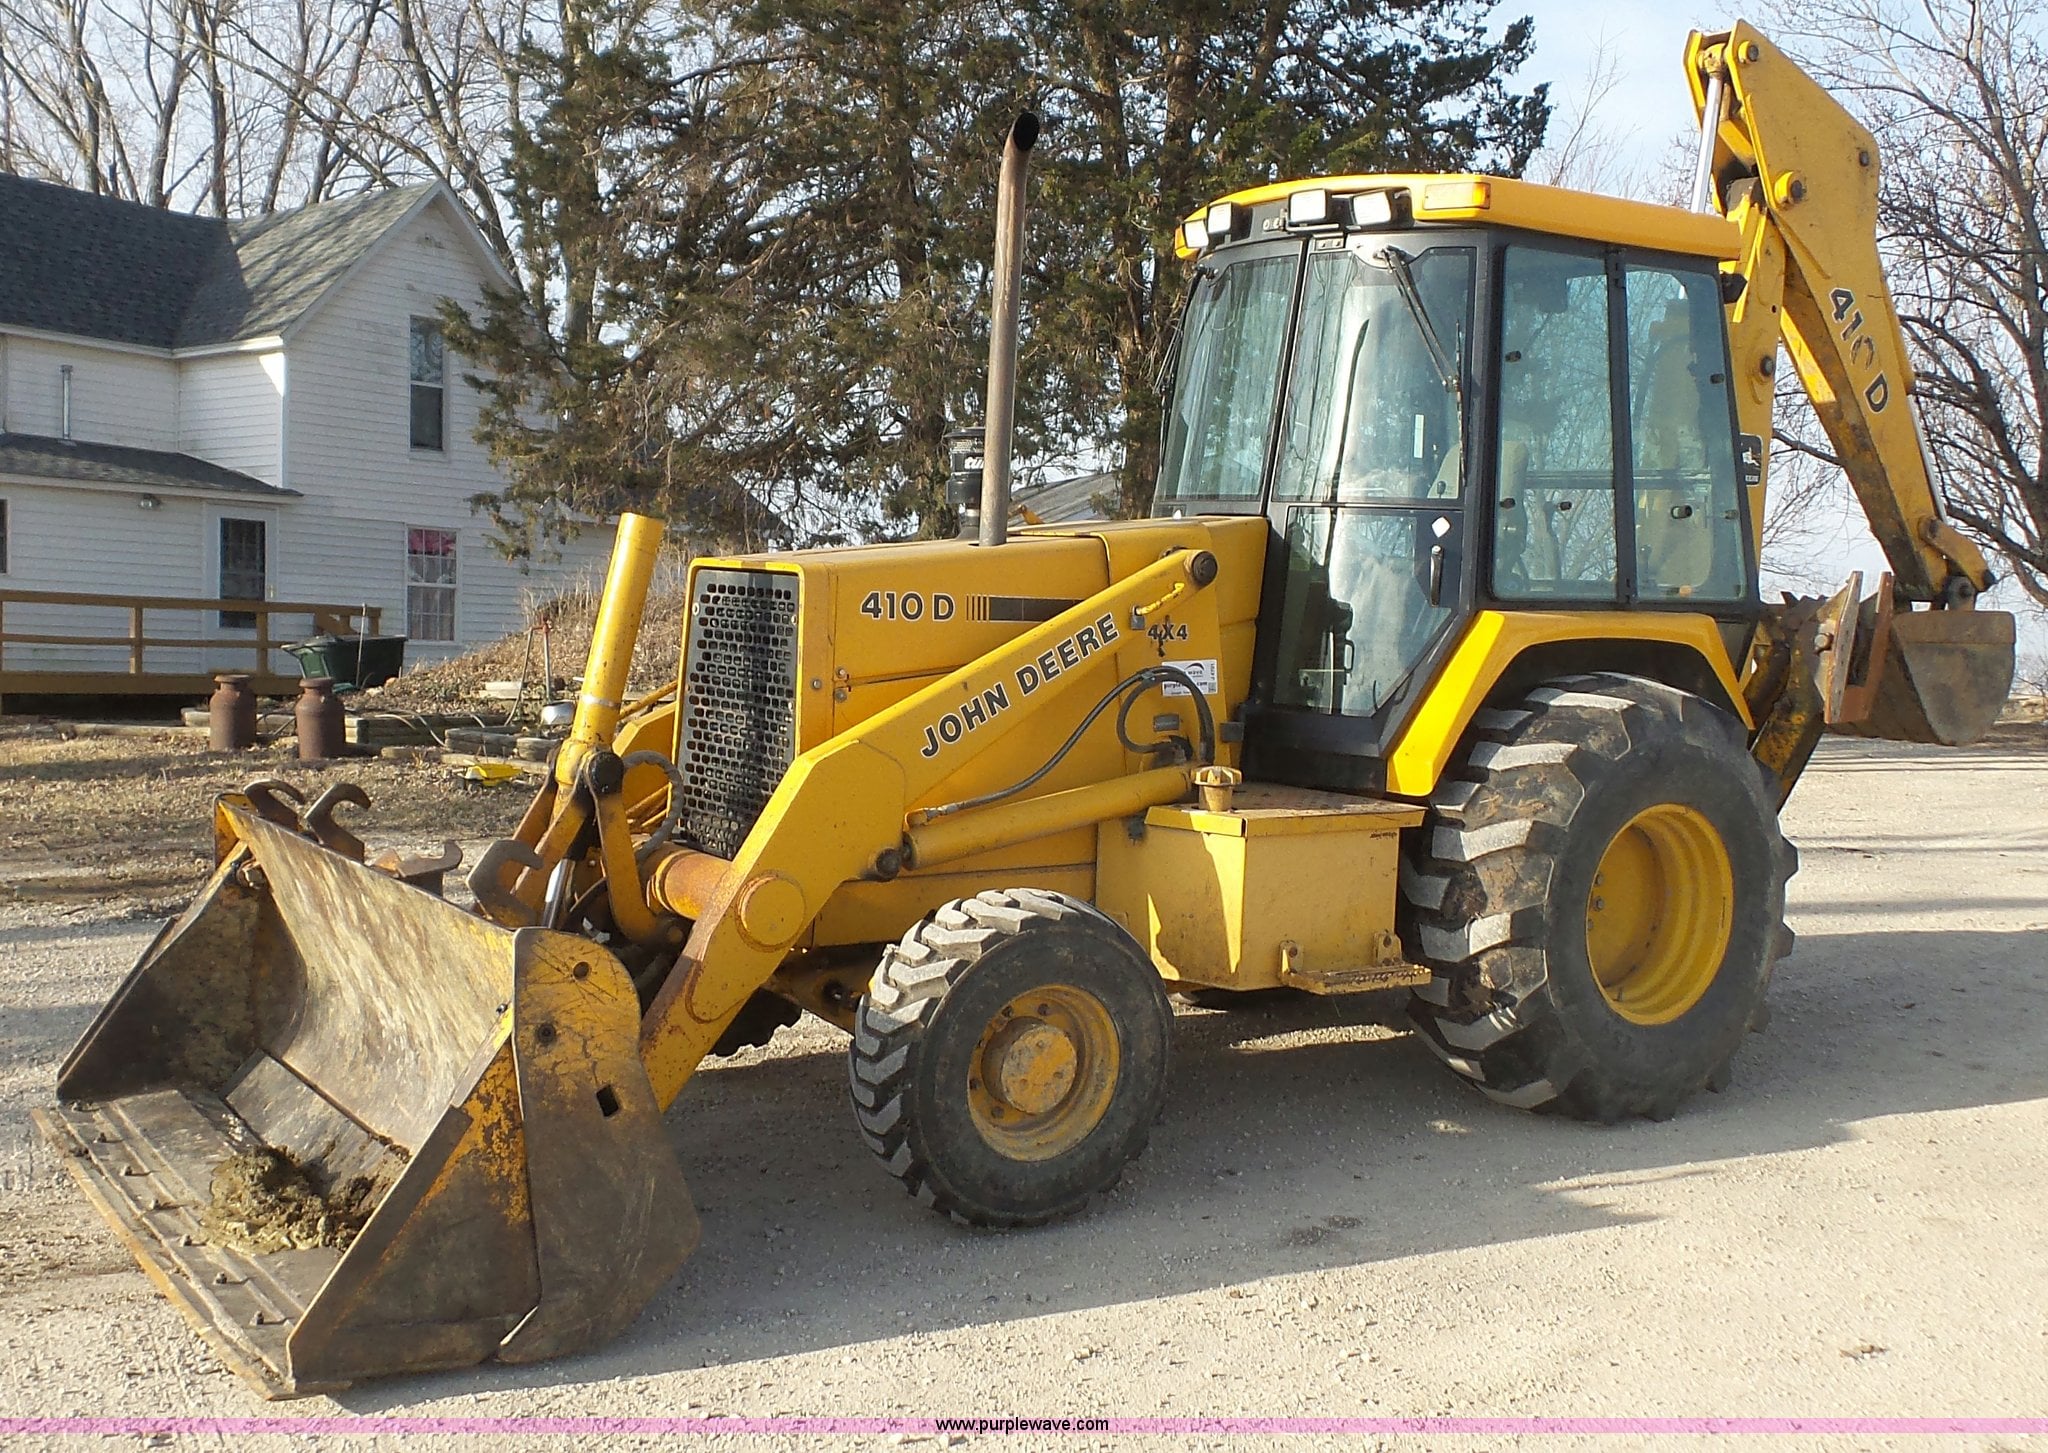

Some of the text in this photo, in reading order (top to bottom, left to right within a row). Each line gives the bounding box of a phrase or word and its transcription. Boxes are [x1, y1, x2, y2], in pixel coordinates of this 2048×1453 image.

[1864, 372, 1891, 414] D
[861, 591, 955, 622] 410 D
[921, 613, 1119, 758] JOHN DEERE
